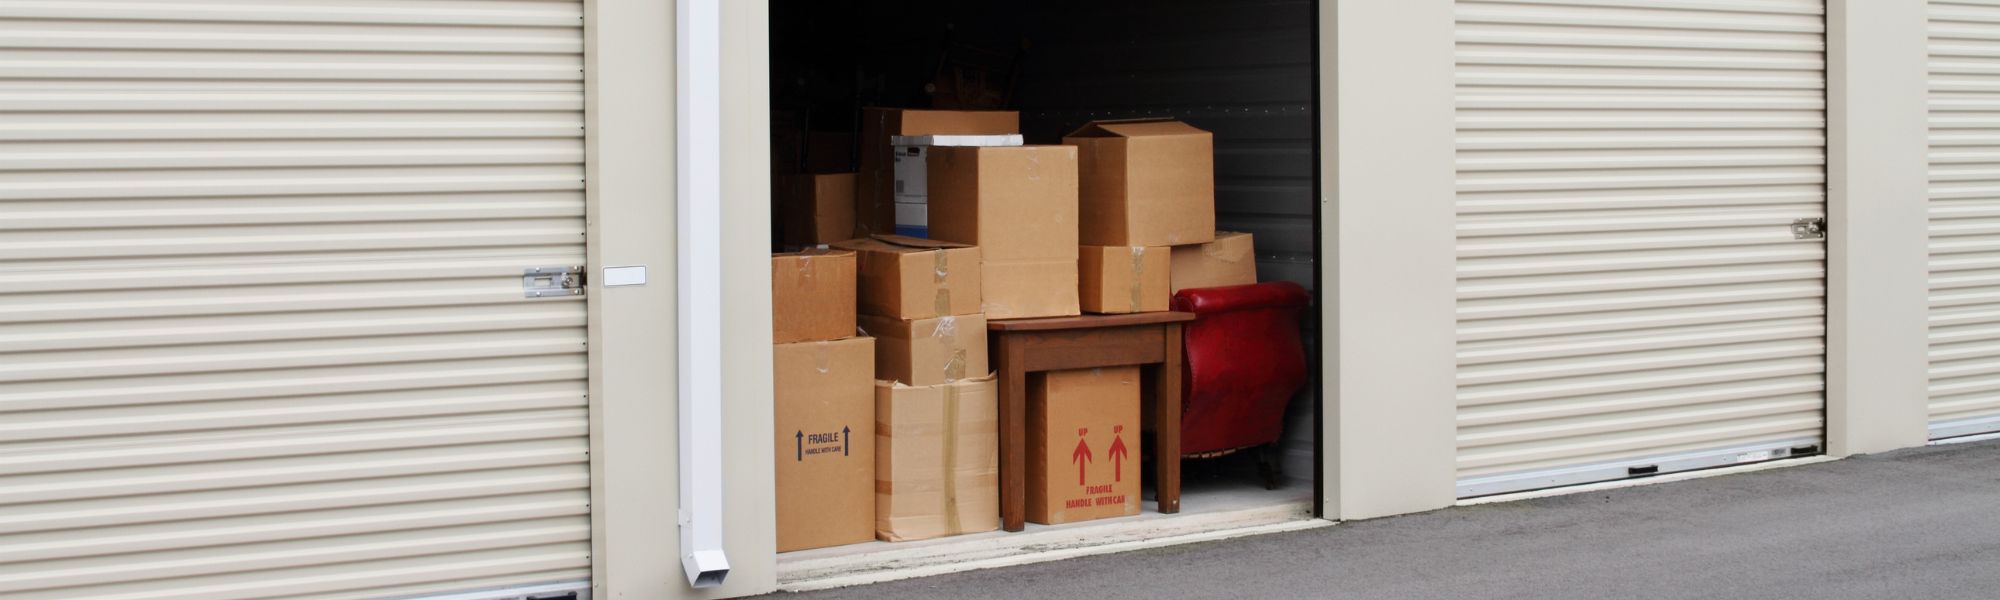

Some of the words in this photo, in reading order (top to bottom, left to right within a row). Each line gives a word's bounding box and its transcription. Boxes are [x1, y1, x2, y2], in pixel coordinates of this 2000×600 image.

[1078, 427, 1088, 437] UP
[1114, 425, 1123, 434] UP
[808, 432, 839, 445] FRAGILE
[1086, 484, 1112, 495] FRAGILE
[1066, 498, 1092, 509] HANDLE
[1095, 496, 1112, 506] WITH
[1113, 495, 1125, 504] CAR
